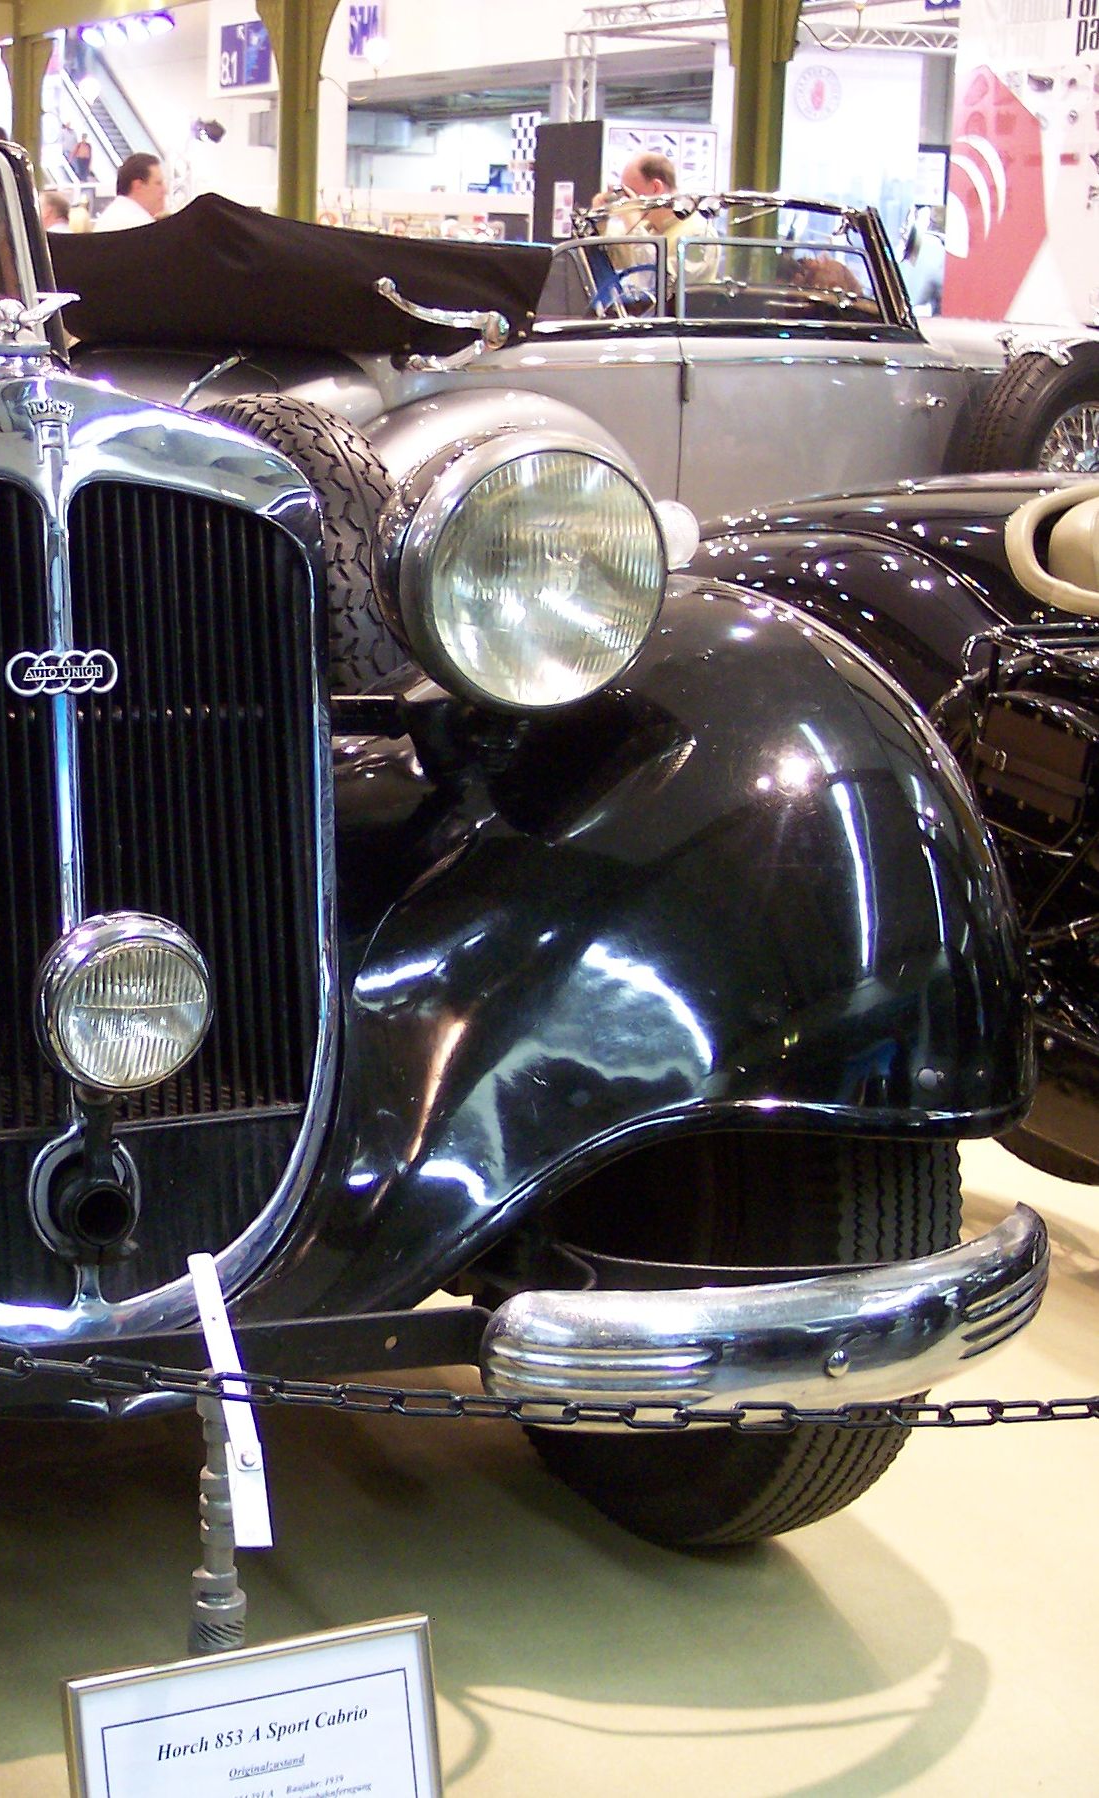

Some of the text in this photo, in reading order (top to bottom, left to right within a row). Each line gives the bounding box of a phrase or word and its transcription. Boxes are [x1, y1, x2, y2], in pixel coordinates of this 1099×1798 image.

[23, 666, 102, 680] AUTO UNION
[157, 1704, 368, 1761] Horch 853 A Sport Cabrio
